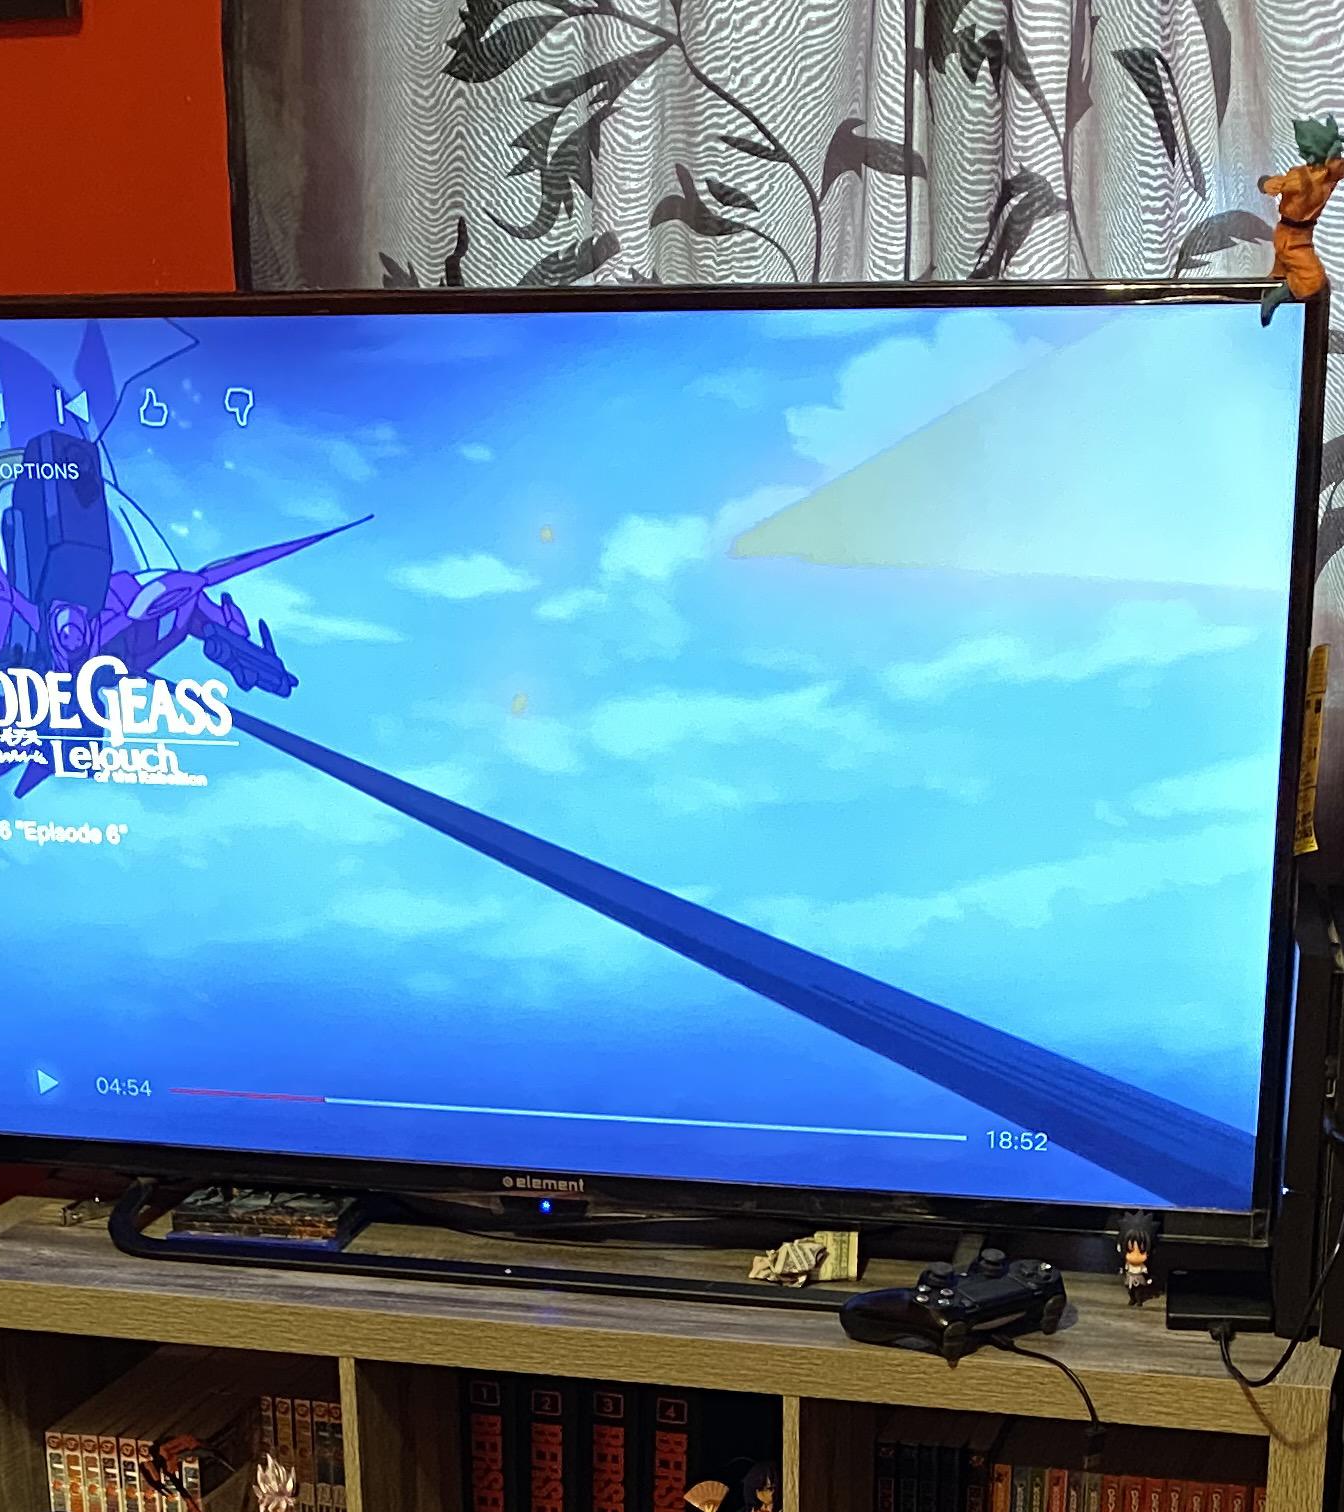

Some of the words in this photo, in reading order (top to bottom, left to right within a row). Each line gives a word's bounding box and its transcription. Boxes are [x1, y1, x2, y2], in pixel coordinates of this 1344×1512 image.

[0, 463, 80, 480] OPTIONS
[76, 655, 233, 747] GEASS
[52, 739, 181, 780] Lelouch
[14, 820, 104, 846] "Episode
[105, 823, 129, 844] 6"
[96, 1076, 152, 1097] 04:54
[986, 1130, 1048, 1151] 18:52
[516, 1175, 584, 1192] element
[481, 1387, 488, 1401] 1
[541, 1397, 552, 1410] 2
[604, 1398, 614, 1413] 3
[665, 1405, 676, 1418] 4
